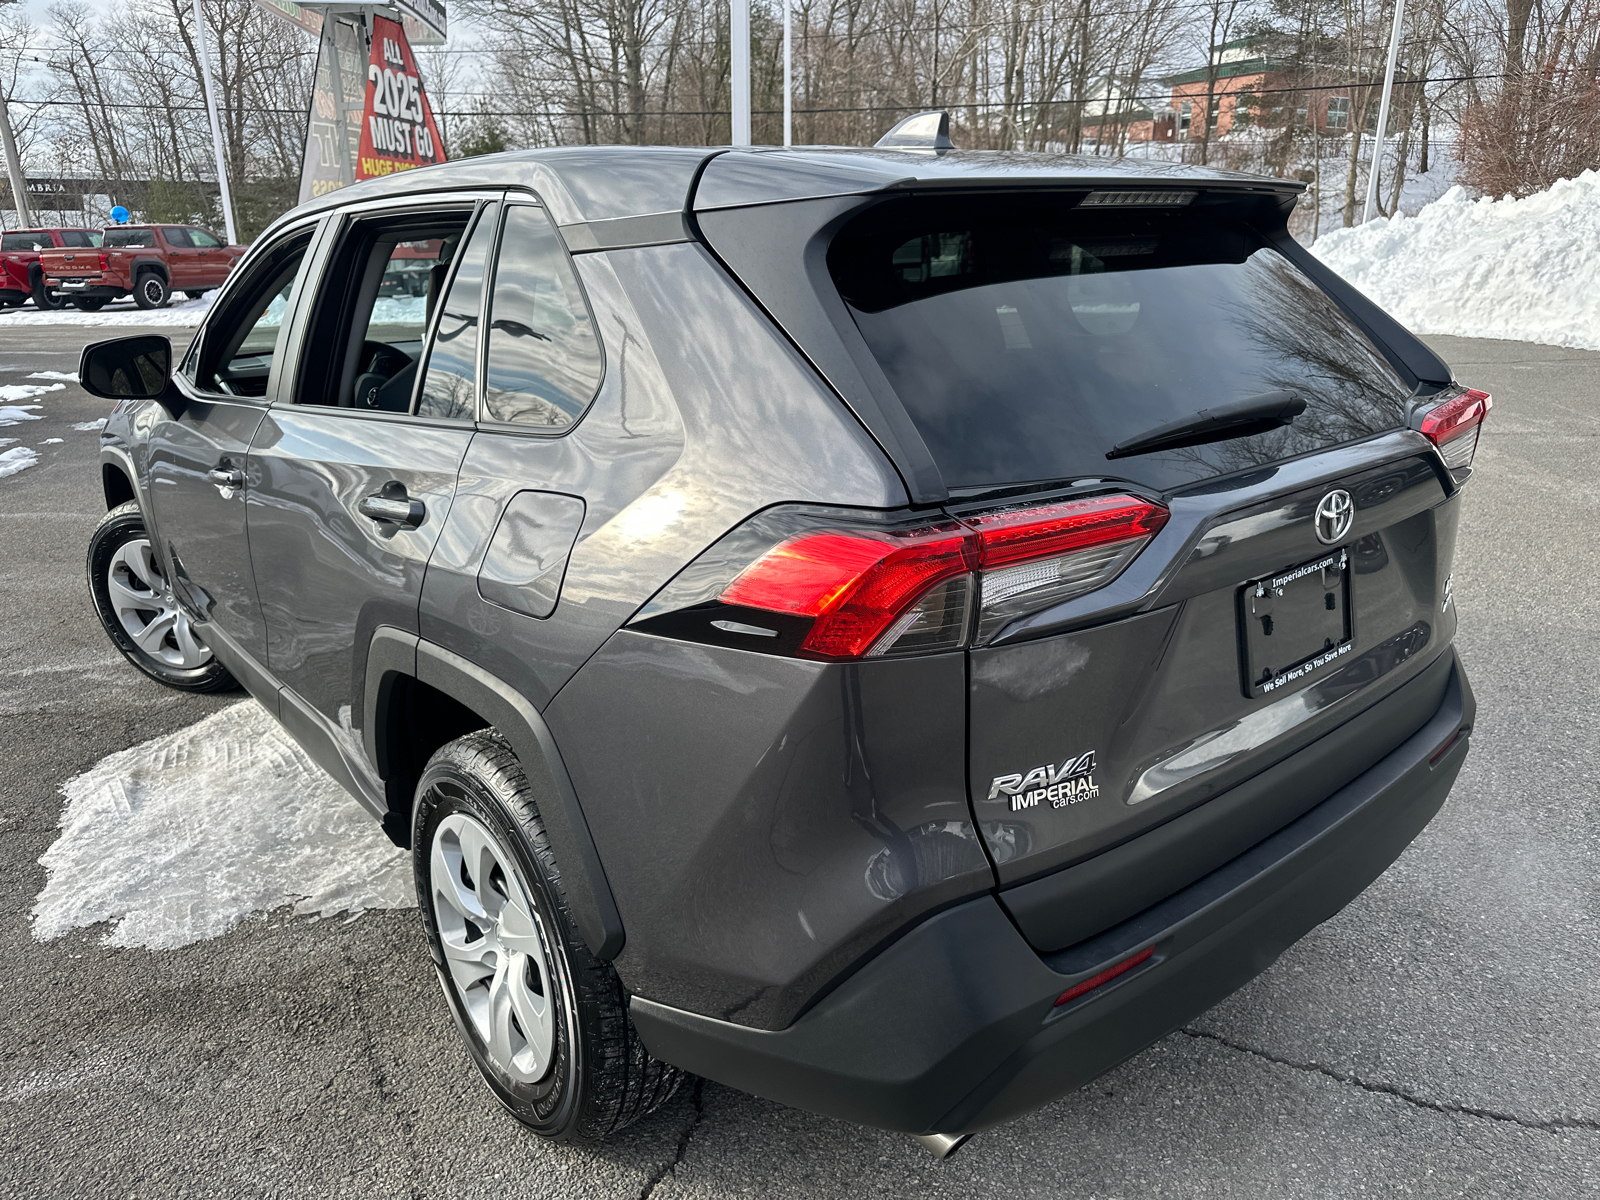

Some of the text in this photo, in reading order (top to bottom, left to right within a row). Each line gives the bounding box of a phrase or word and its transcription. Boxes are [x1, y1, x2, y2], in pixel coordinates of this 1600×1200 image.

[383, 37, 404, 66] ALL
[368, 64, 423, 123] 2025
[368, 115, 412, 153] MUST
[414, 124, 434, 158] GO
[361, 157, 393, 176] HUGE
[1272, 557, 1334, 588] Imperialcars.com
[1263, 643, 1352, 693] We Sell More, So You Save More
[987, 749, 1097, 800] RAV4
[1011, 775, 1099, 812] IMPERIAL
[1052, 788, 1100, 809] cars.com
